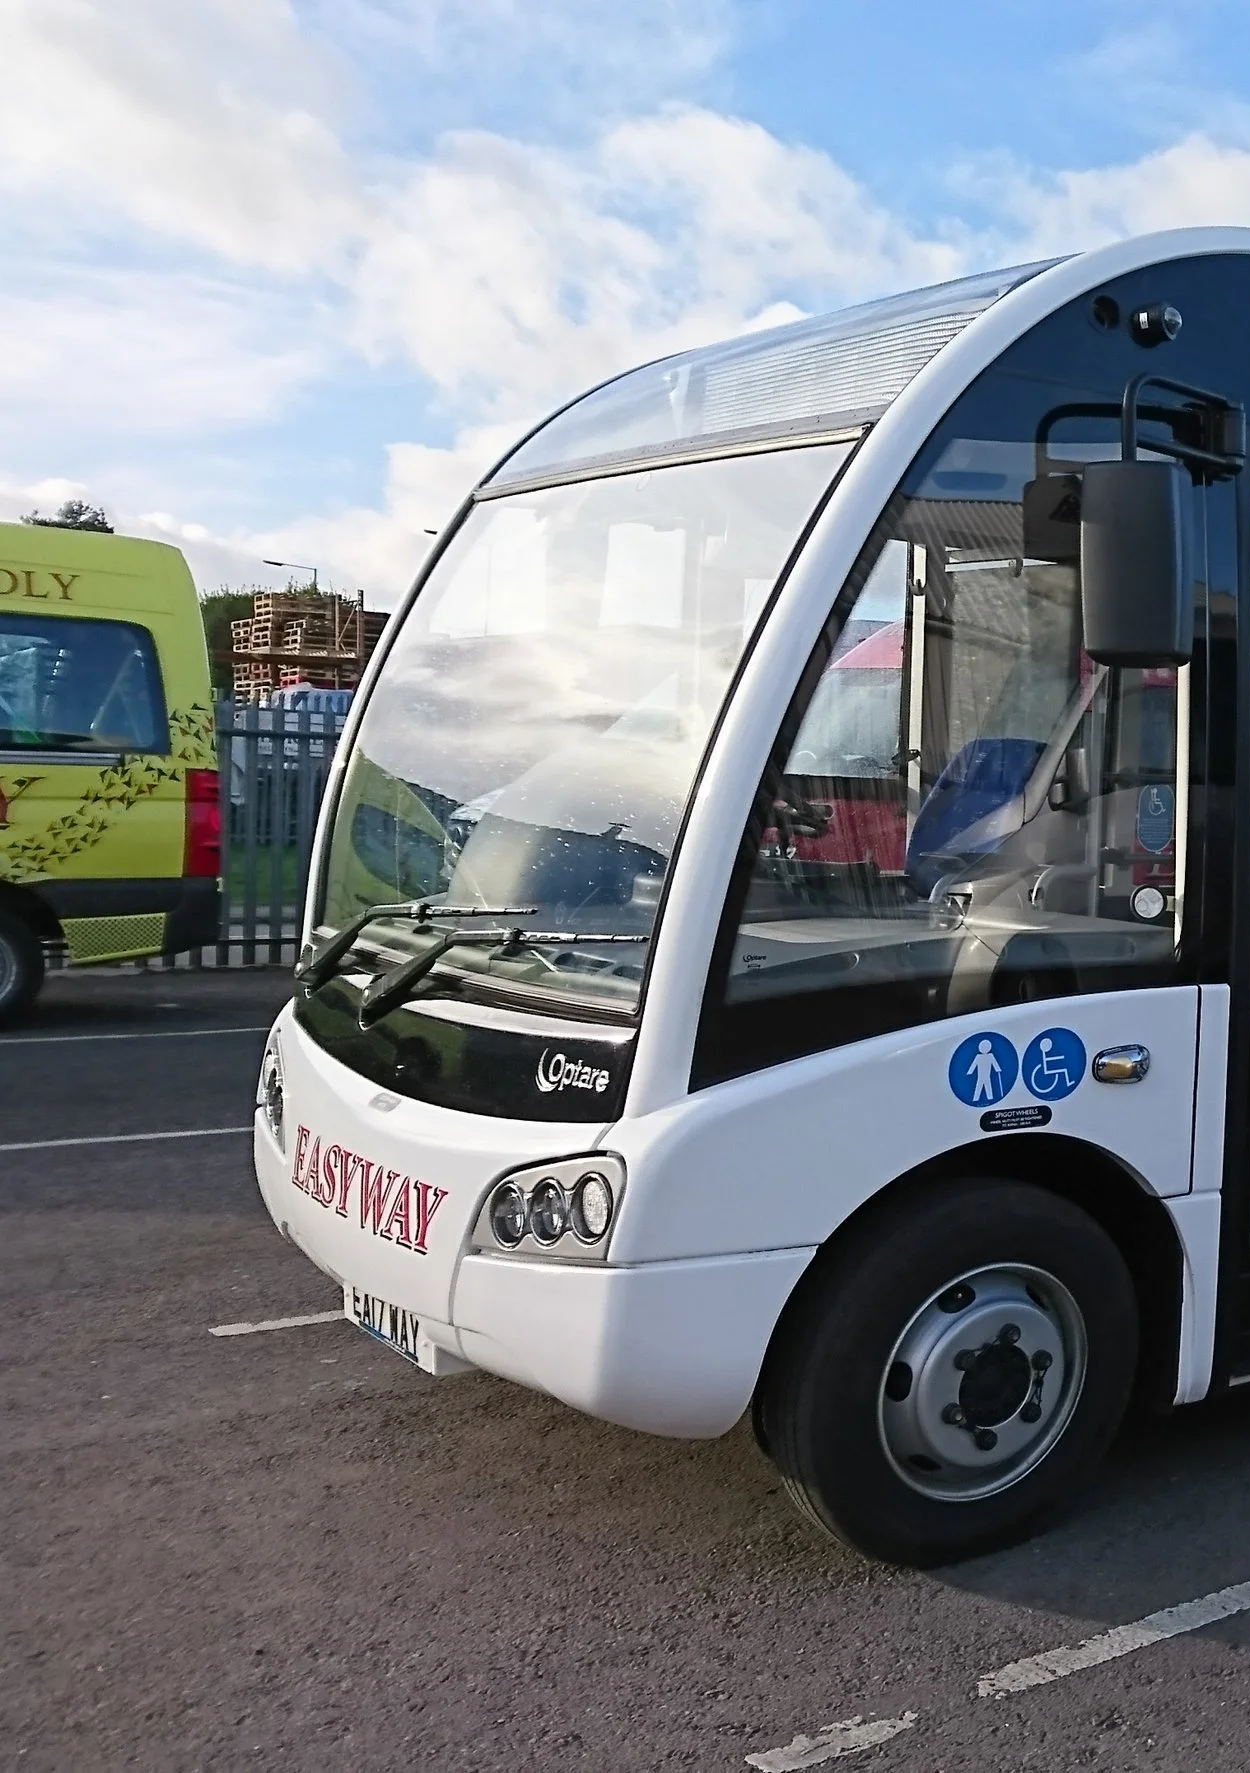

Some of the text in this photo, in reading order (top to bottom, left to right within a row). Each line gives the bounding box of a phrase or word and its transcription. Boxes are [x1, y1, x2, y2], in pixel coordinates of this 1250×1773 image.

[546, 1052, 610, 1093] Optare
[994, 1108, 1039, 1119] SPIGOT WHEELS
[291, 1125, 449, 1256] EASYWAY
[389, 1304, 420, 1356] WAY
